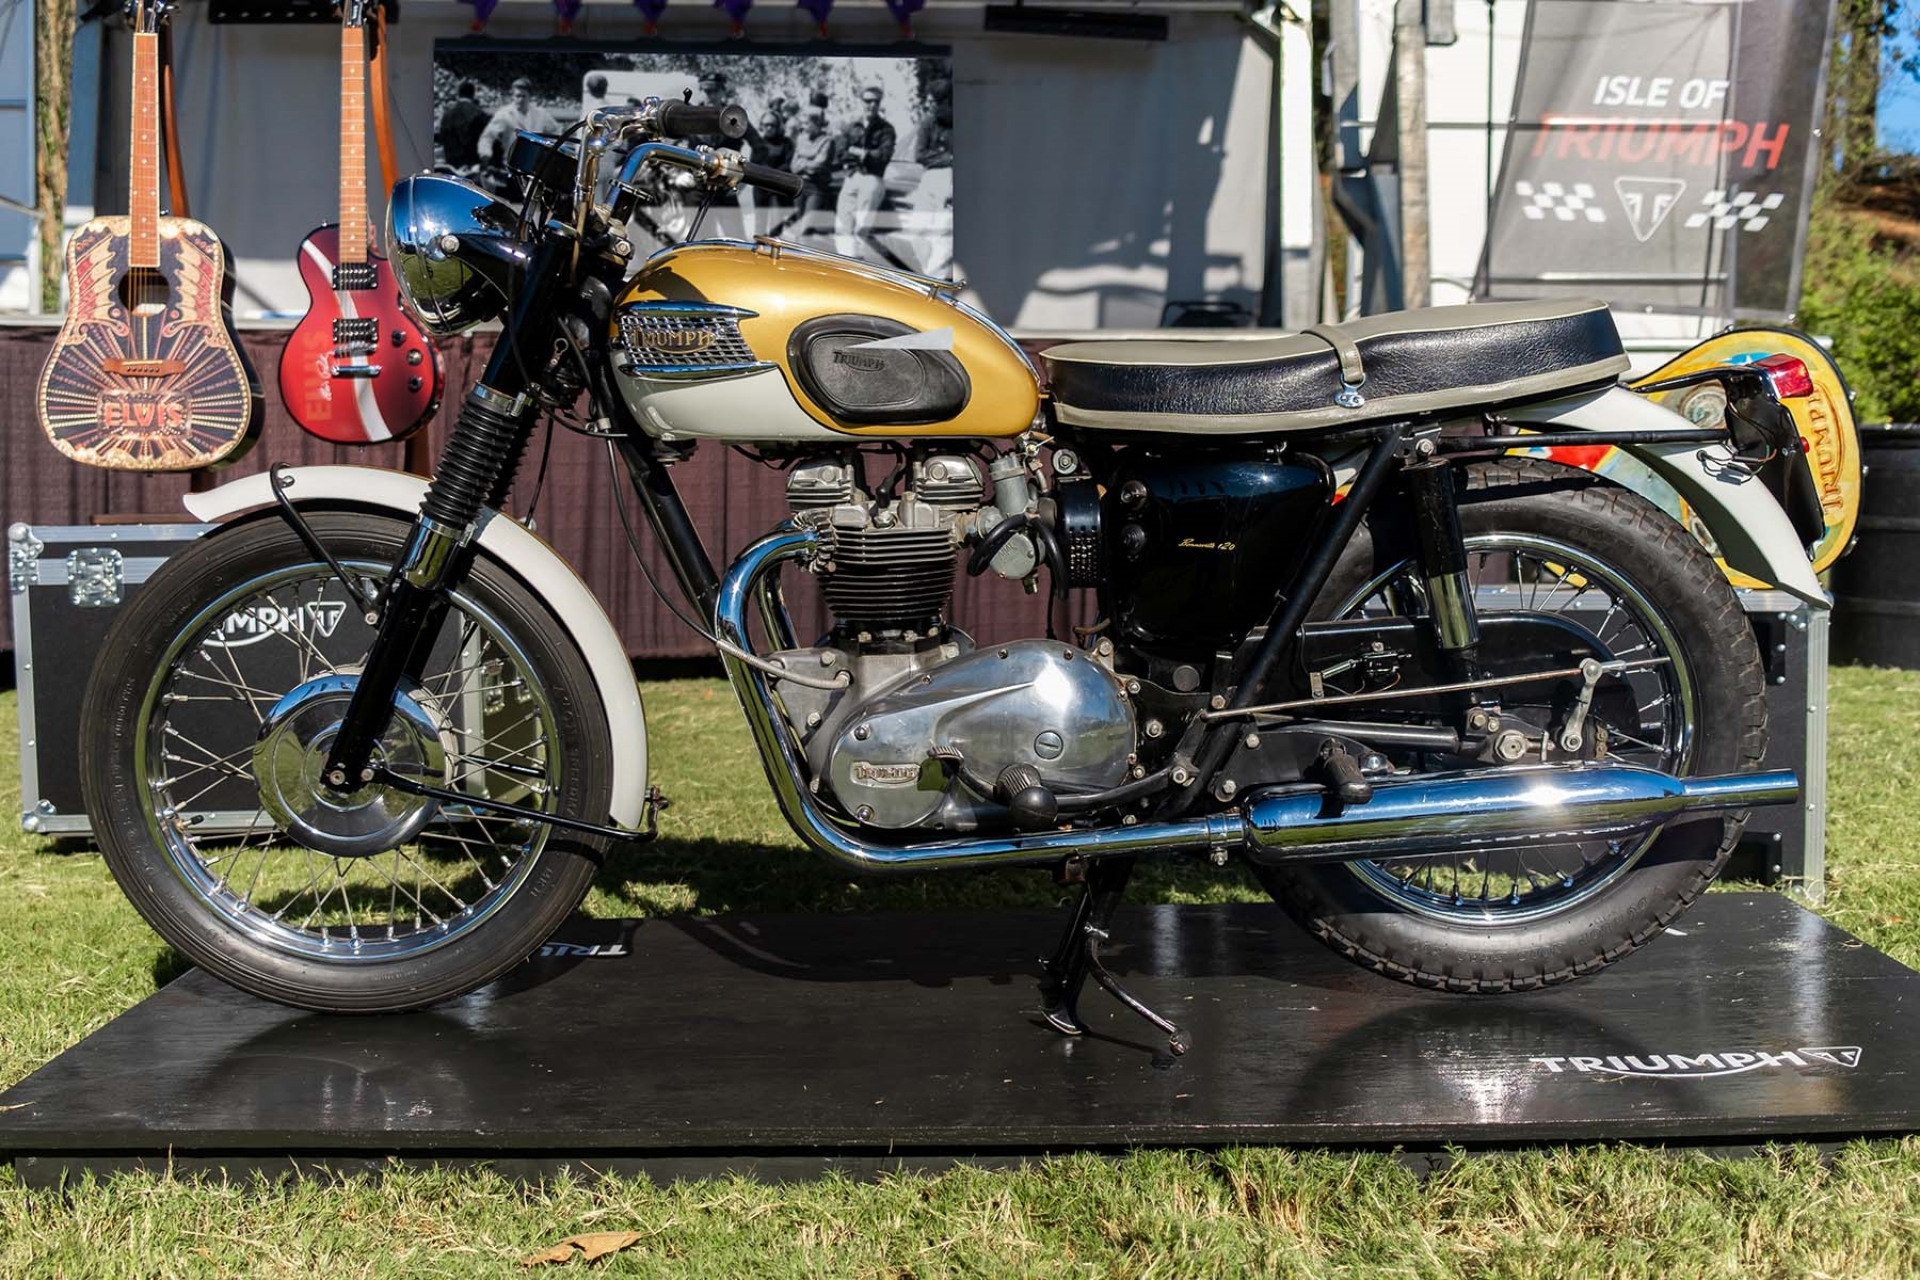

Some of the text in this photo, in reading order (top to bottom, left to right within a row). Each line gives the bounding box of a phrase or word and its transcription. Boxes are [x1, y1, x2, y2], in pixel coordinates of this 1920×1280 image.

[1592, 76, 1730, 109] ISLE OF
[1530, 111, 1791, 169] TRIUMPH
[104, 402, 184, 428] ELVIS
[1529, 1050, 1808, 1073] TRIUMPH
